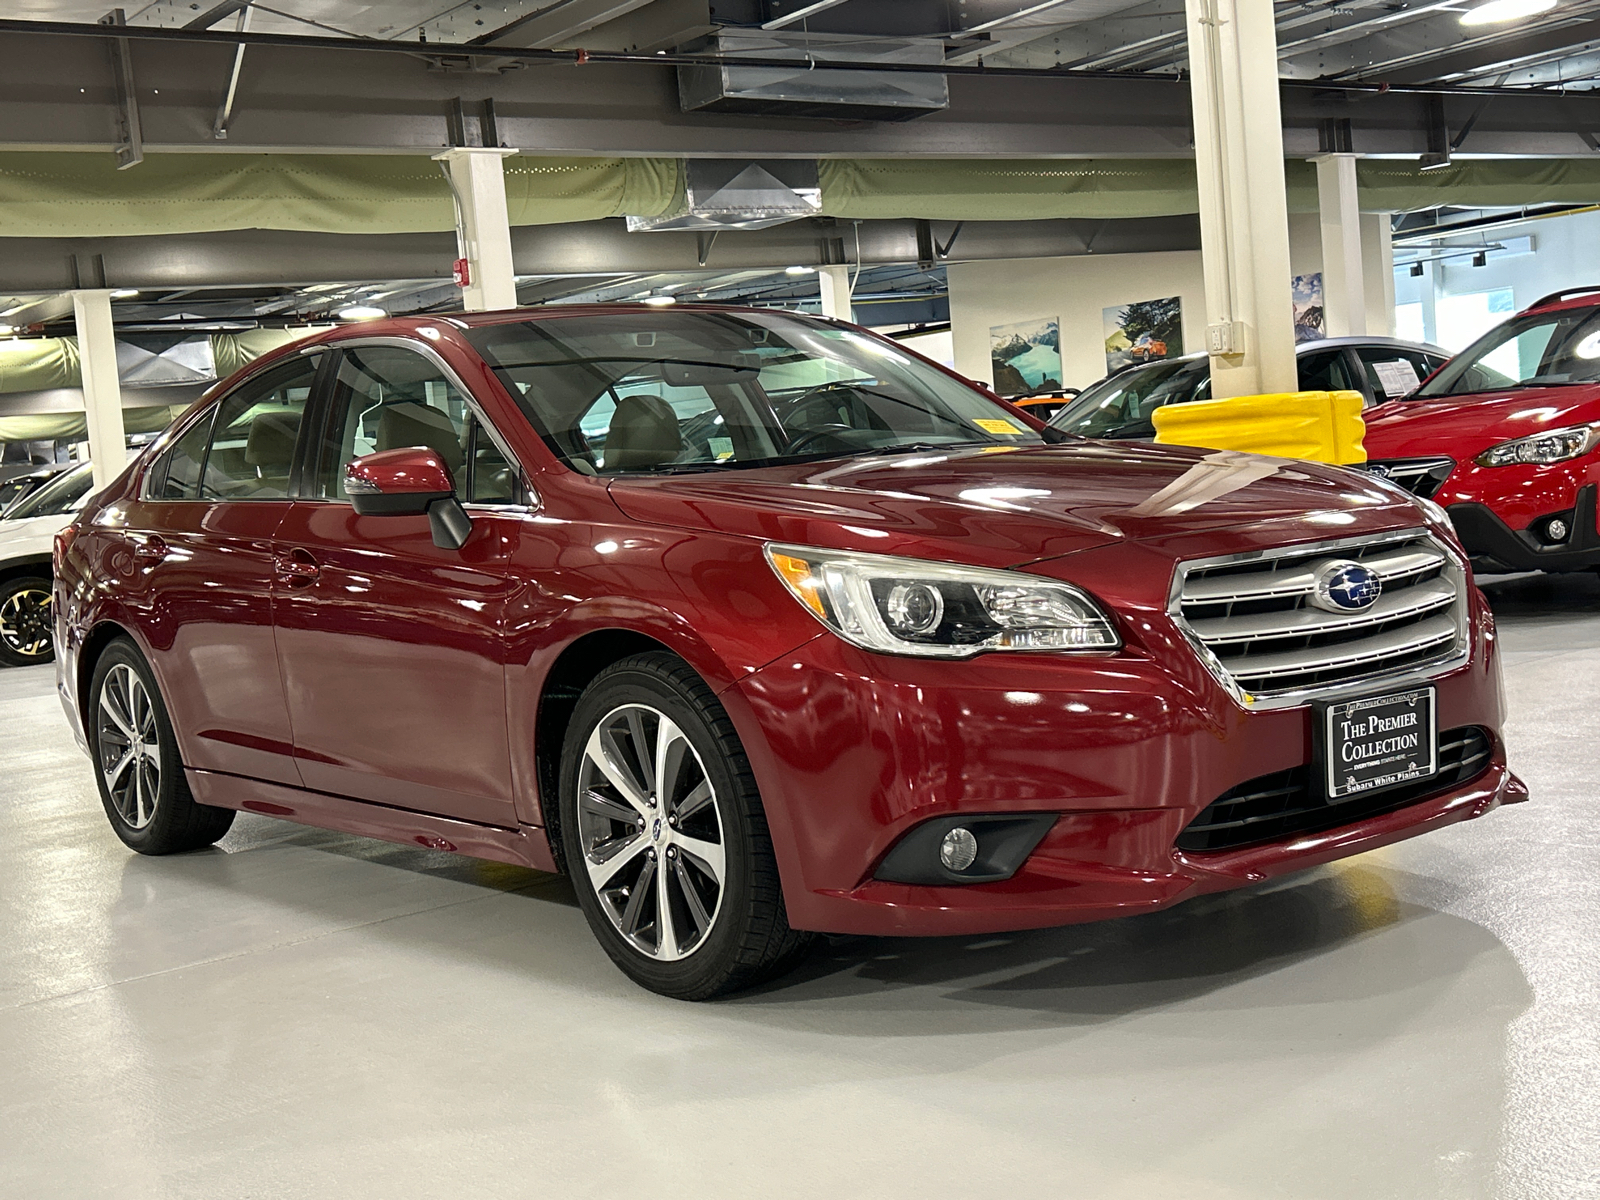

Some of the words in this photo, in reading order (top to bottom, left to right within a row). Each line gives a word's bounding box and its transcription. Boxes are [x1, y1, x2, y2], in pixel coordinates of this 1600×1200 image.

[1341, 720, 1366, 740] THE
[1368, 712, 1418, 734] PREMIER
[1342, 733, 1418, 762] COLLECTION
[1347, 782, 1373, 792] Subaru
[1374, 775, 1396, 786] White
[1397, 770, 1420, 781] Plains
